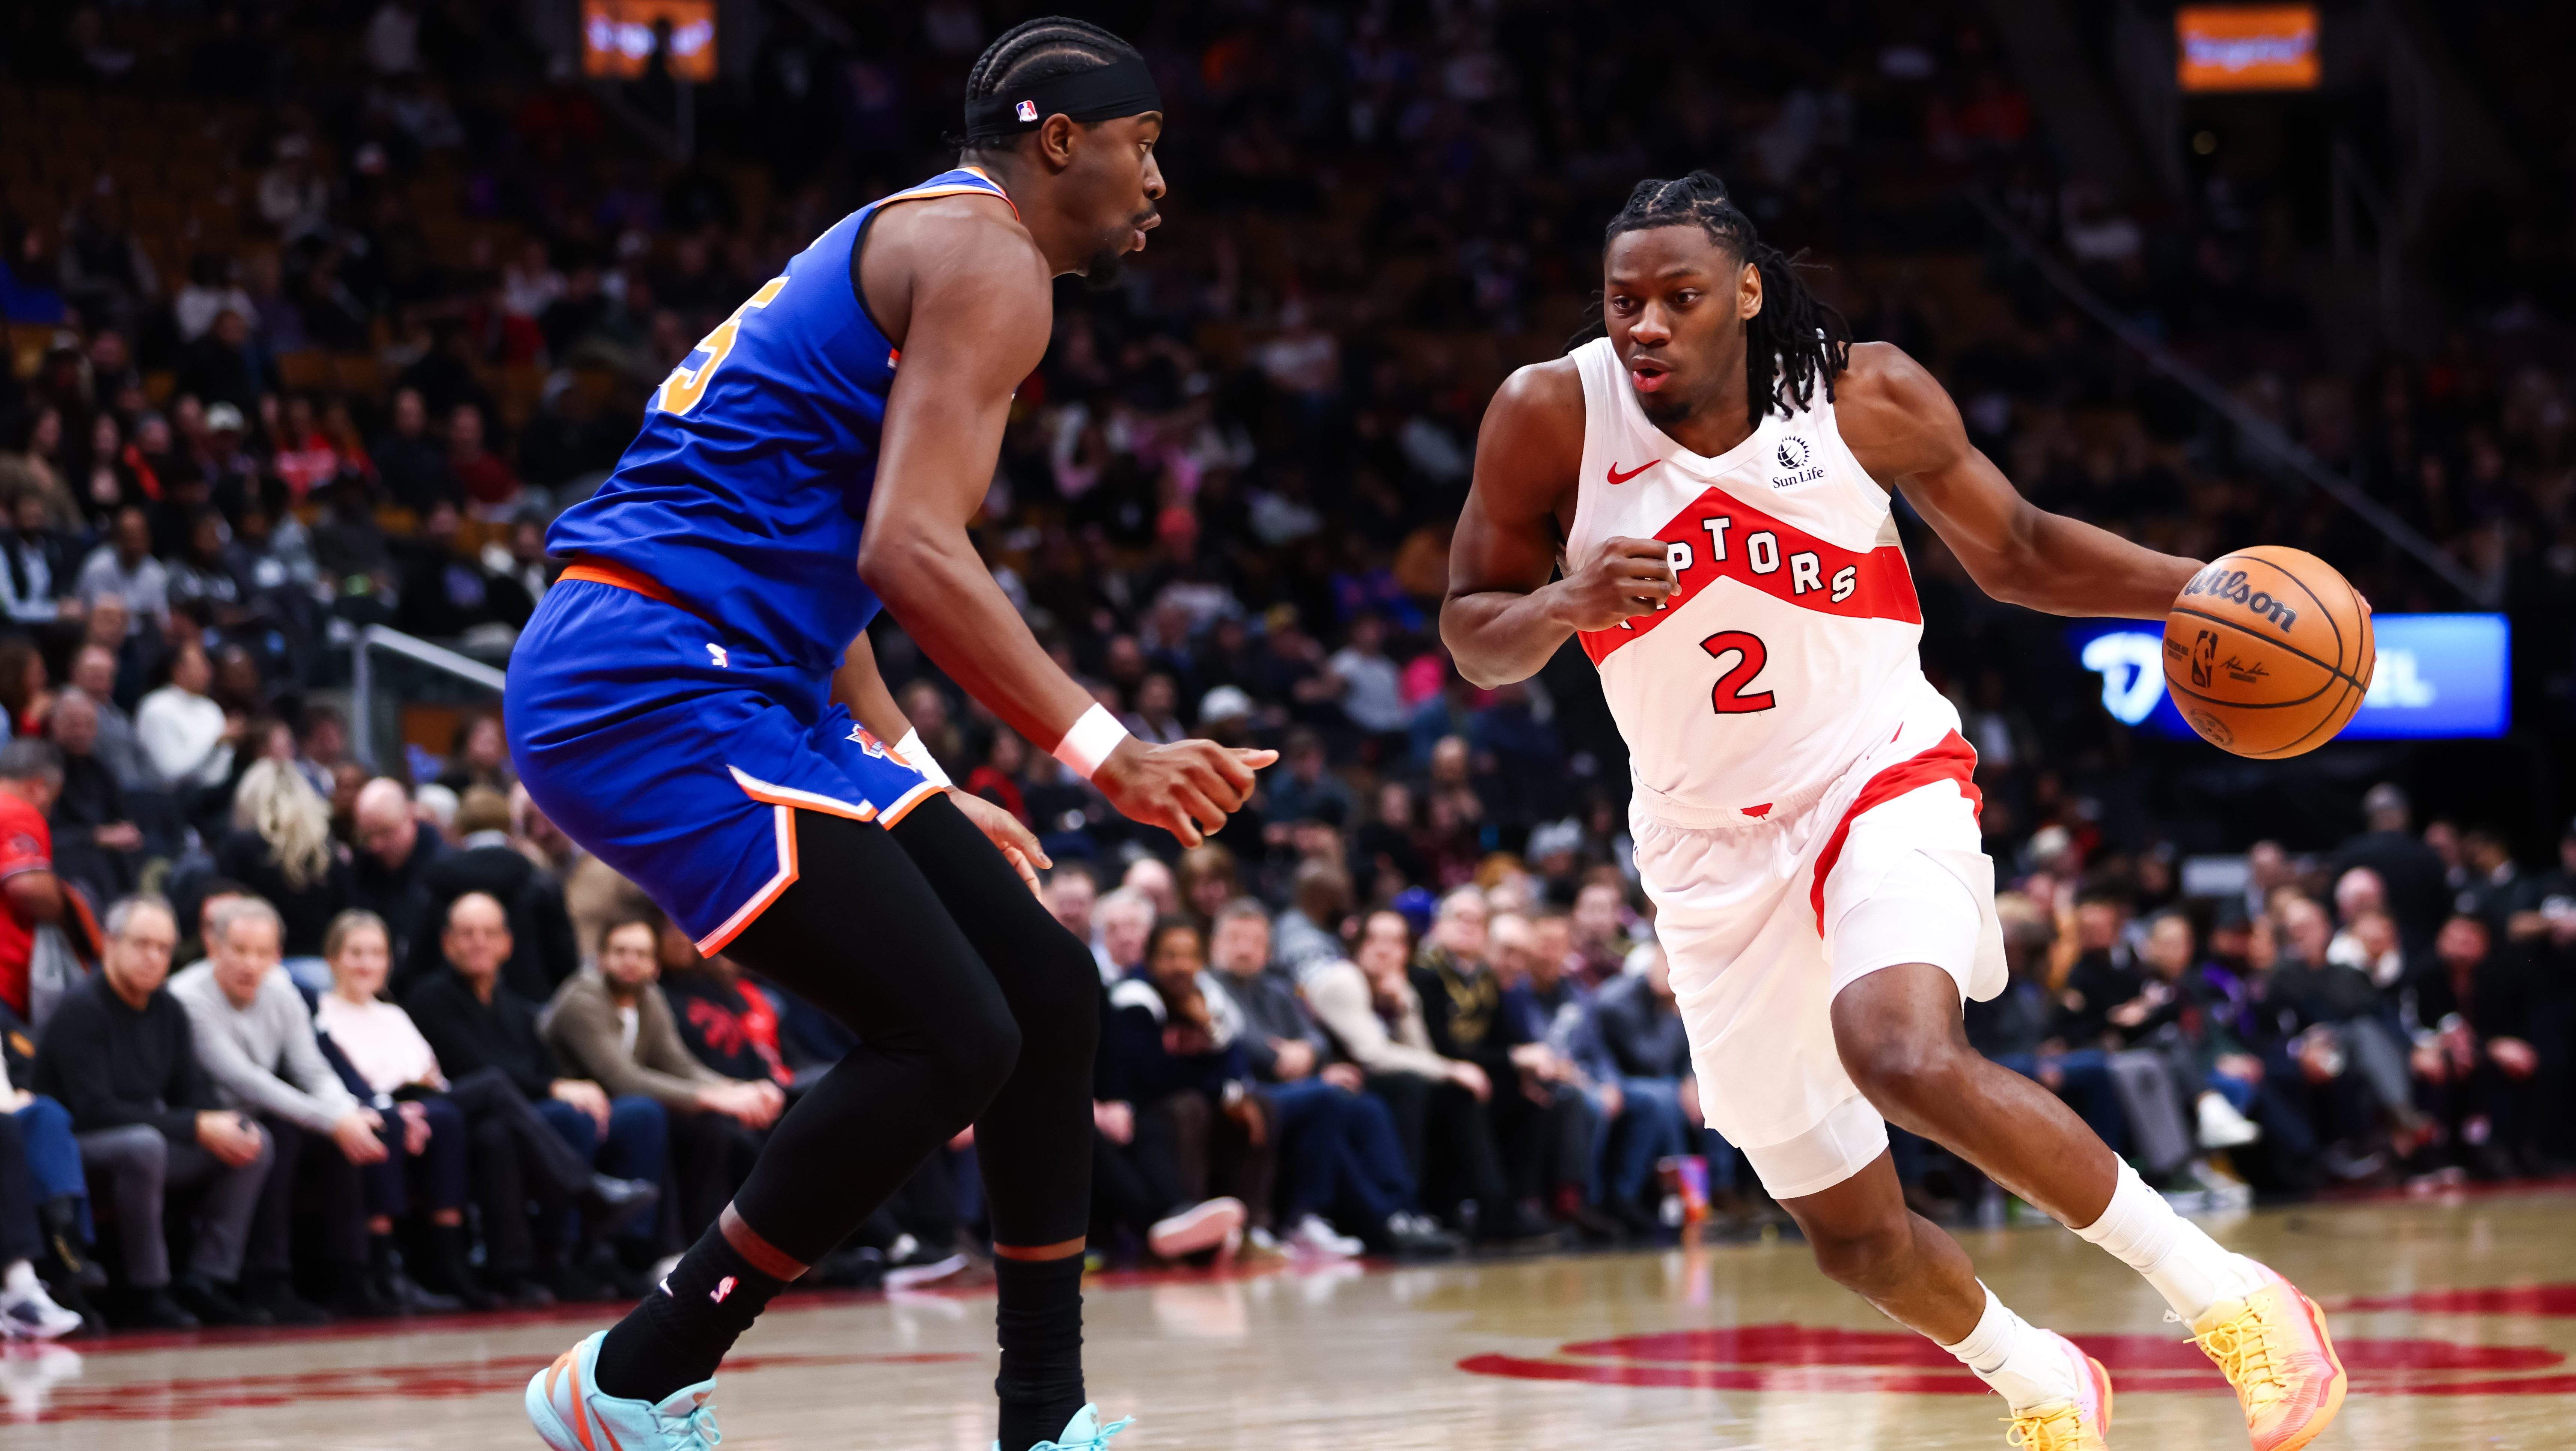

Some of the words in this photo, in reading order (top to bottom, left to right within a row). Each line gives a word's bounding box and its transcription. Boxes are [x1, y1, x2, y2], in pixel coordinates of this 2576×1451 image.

[1773, 477, 1798, 488] Sun
[1799, 467, 1824, 482] Life
[1613, 515, 1857, 631] PTORS
[2184, 568, 2297, 633] Wilson
[1699, 630, 1776, 714] 2
